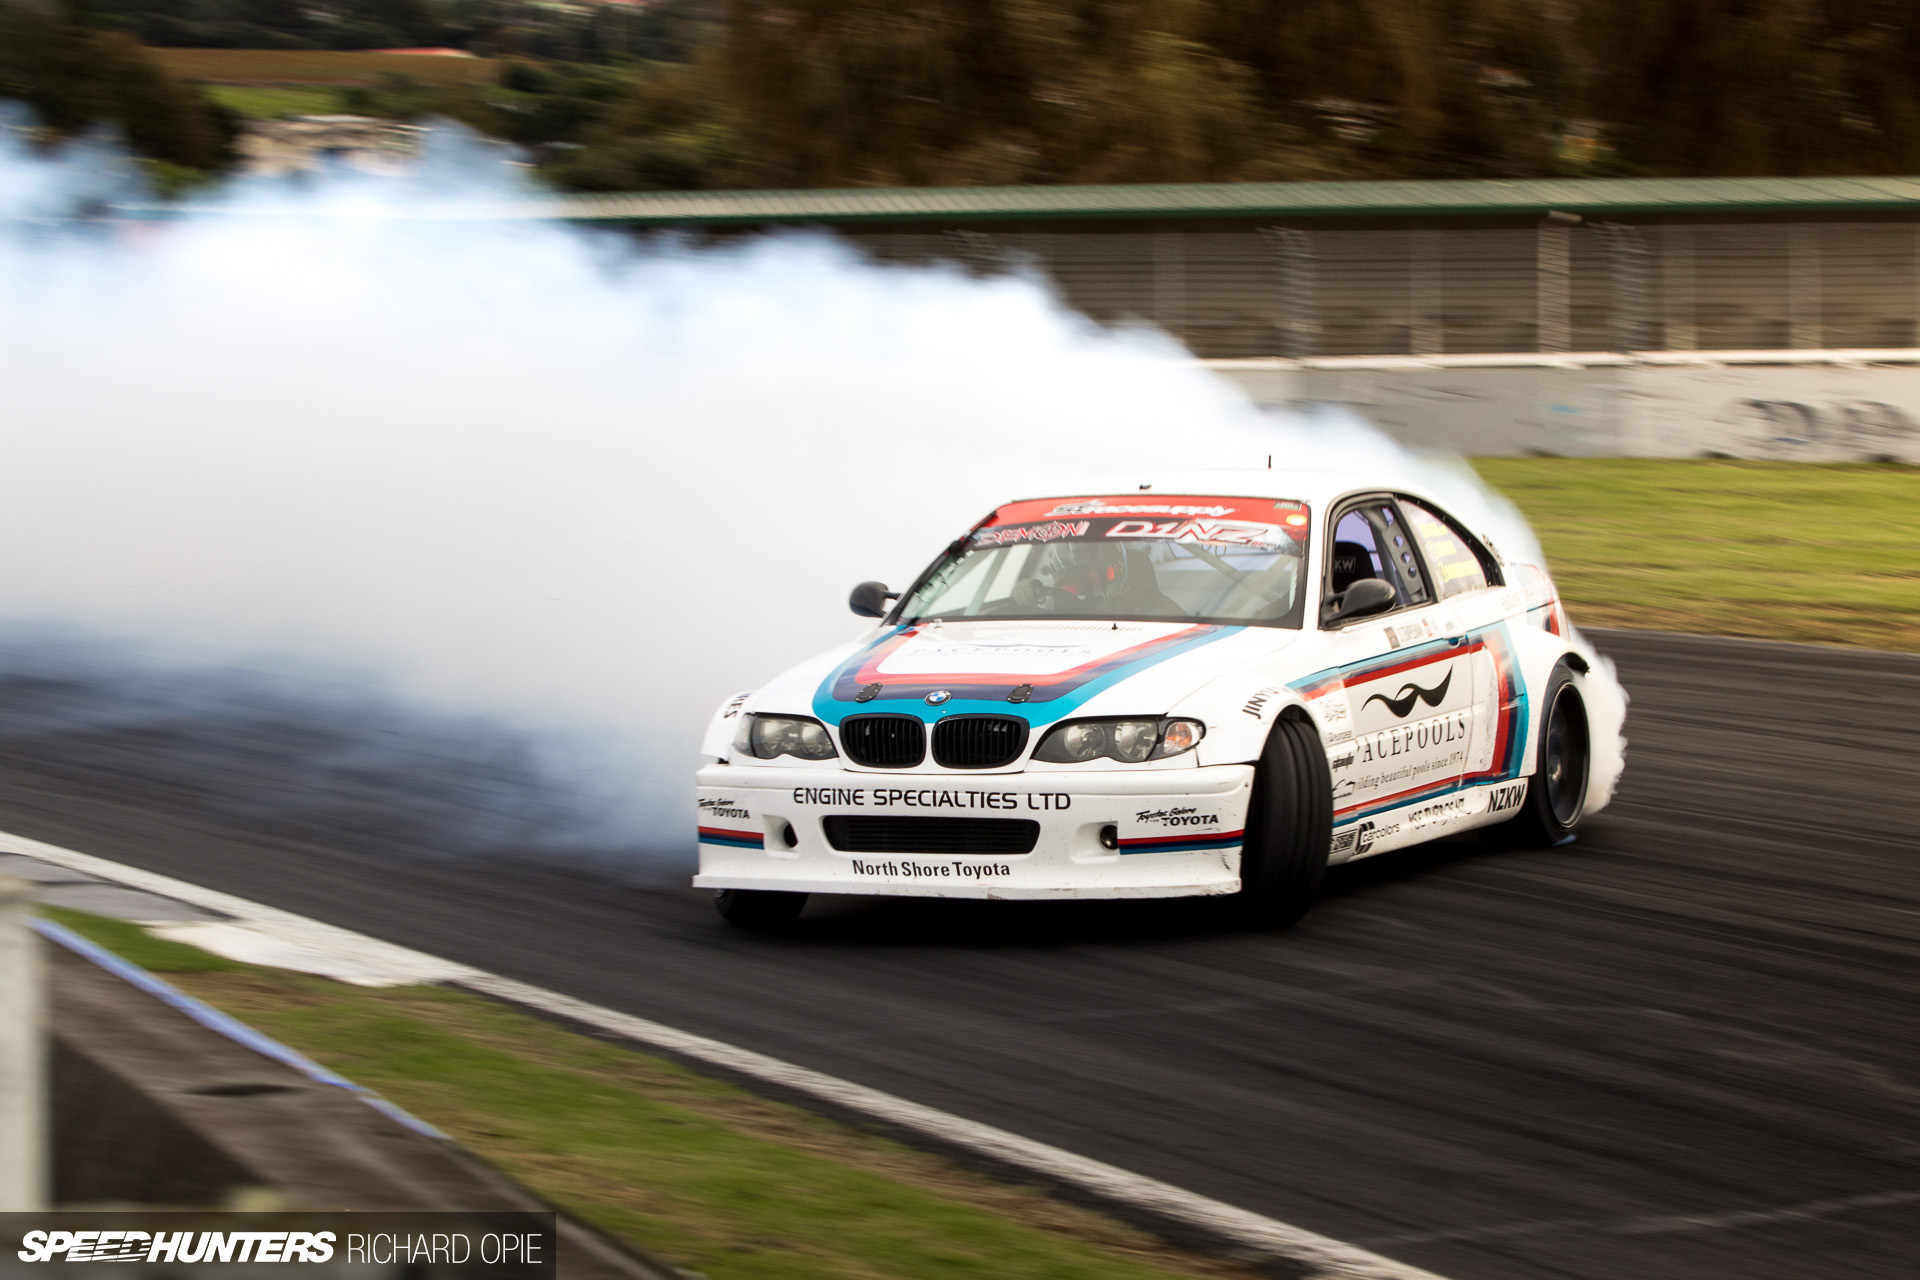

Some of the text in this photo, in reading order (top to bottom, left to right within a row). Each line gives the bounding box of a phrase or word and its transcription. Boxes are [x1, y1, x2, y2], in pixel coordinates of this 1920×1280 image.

[1104, 519, 1268, 545] D1NZ
[793, 787, 1072, 811] ENGINE SPECIALTIES LTD
[1487, 784, 1526, 813] NZKW
[712, 807, 750, 819] TOYOTA
[1161, 814, 1219, 827] TOYOTA
[1362, 823, 1400, 843] carcolors
[852, 860, 1010, 880] North Shore Toyota
